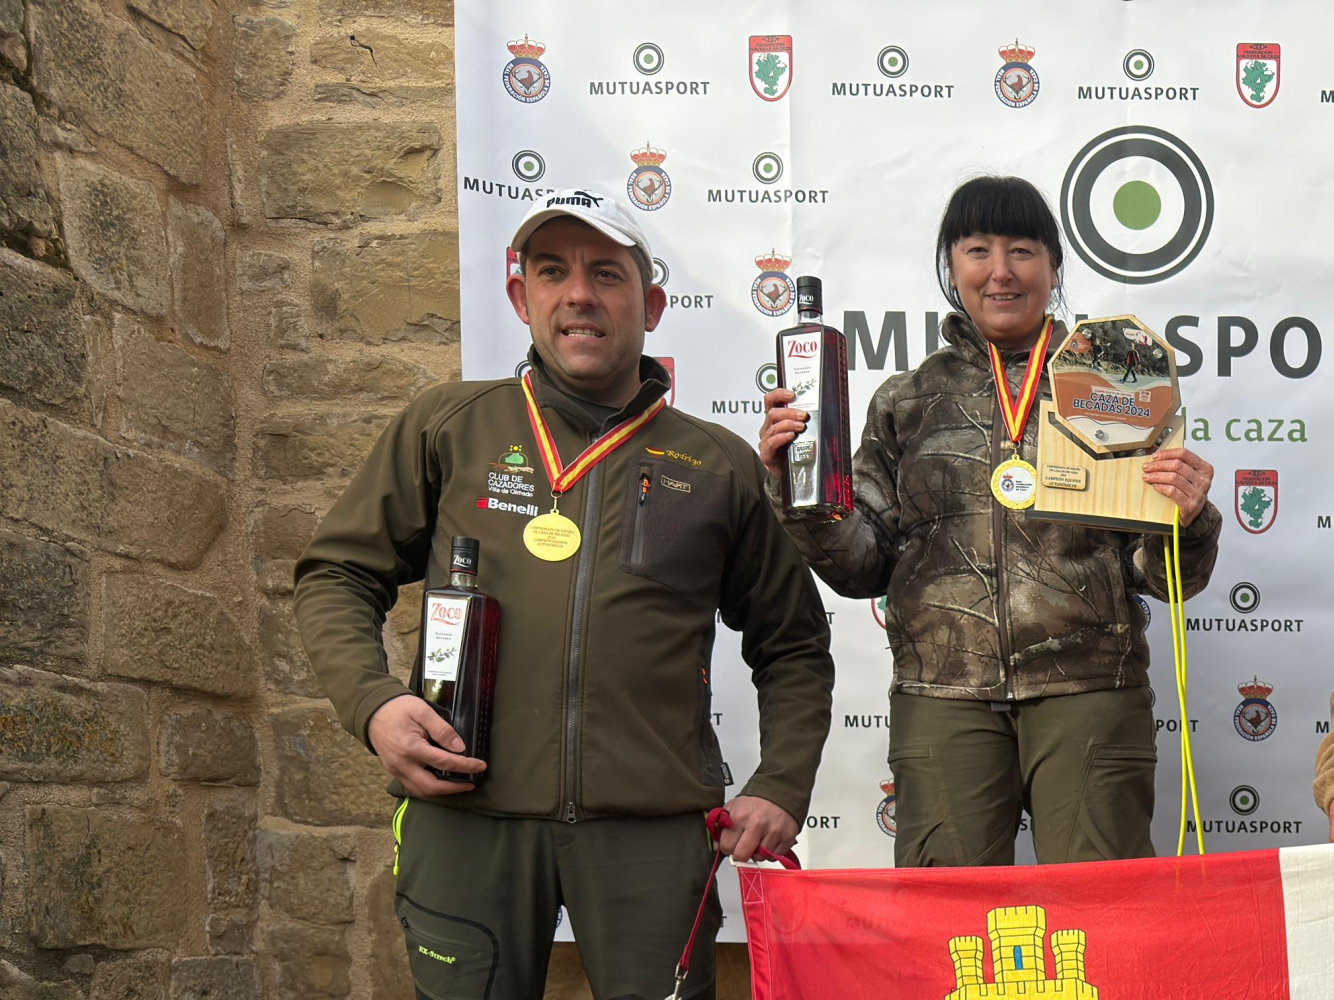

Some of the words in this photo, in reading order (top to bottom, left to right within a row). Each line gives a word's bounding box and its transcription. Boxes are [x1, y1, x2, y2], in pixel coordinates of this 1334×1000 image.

[588, 81, 710, 95] MUTUASPORT
[831, 83, 955, 98] MUTUASPORT
[1077, 86, 1200, 101] MUTUASPORT
[546, 196, 592, 208] PUMA
[707, 189, 829, 203] MUTUASPORT
[1090, 392, 1120, 405] CAZA
[1122, 396, 1135, 407] DE
[1073, 398, 1122, 414] BECADAS
[1125, 406, 1150, 418] 2024
[1225, 419, 1308, 442] caza
[666, 450, 702, 466] Rodrigo
[488, 472, 510, 482] CLUB
[512, 475, 524, 483] DE
[488, 479, 535, 492] CAZADORES
[488, 498, 539, 517] Benelli
[1186, 619, 1303, 632] MUTUASPORT
[1187, 821, 1302, 833] MUTUASPORT
